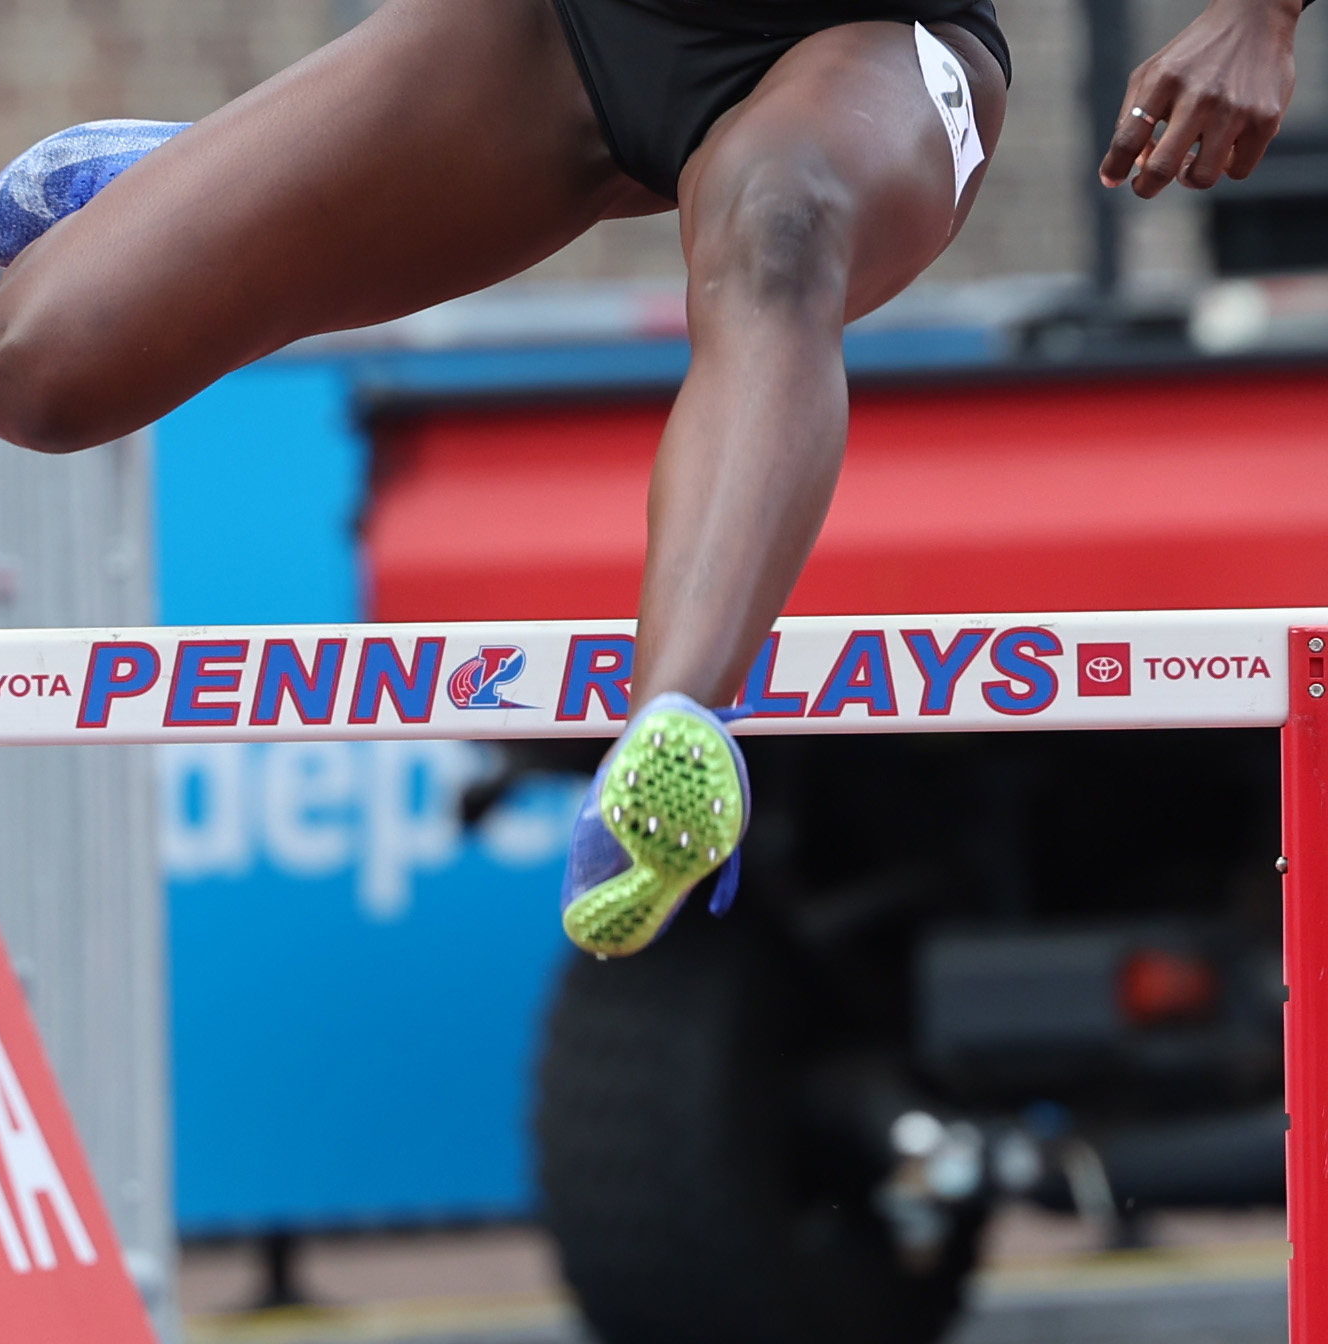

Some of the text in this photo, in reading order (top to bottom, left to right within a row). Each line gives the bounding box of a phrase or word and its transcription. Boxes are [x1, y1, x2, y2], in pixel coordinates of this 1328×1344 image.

[76, 626, 1063, 728] PENN RLAYS
[1144, 655, 1271, 681] TOYOTA
